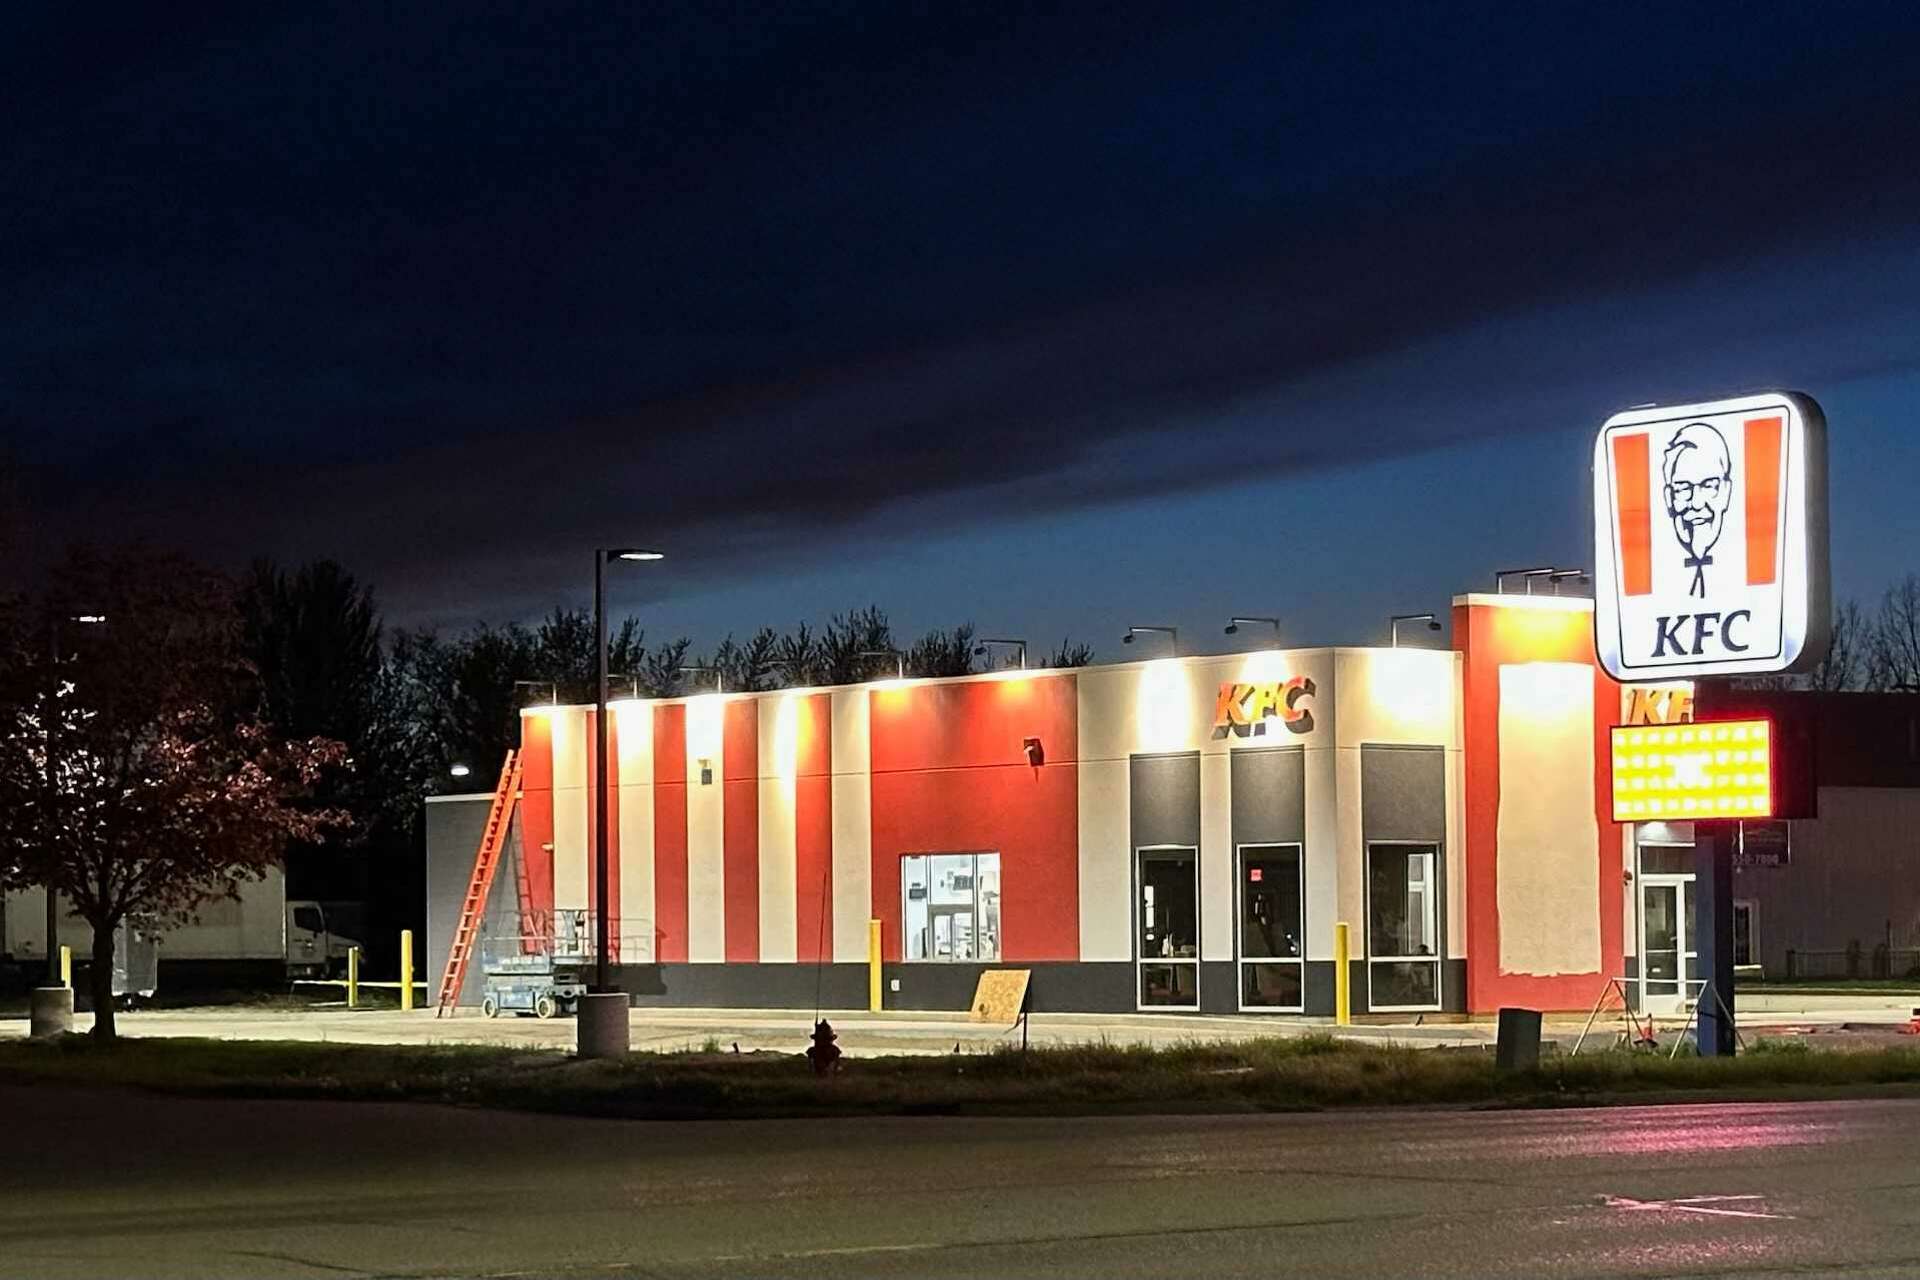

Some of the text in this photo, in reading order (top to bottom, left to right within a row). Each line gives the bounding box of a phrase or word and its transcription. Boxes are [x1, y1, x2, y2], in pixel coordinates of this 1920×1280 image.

[1651, 610, 1750, 657] KFC
[1213, 675, 1310, 728] KFC
[1629, 688, 1694, 724] KF
